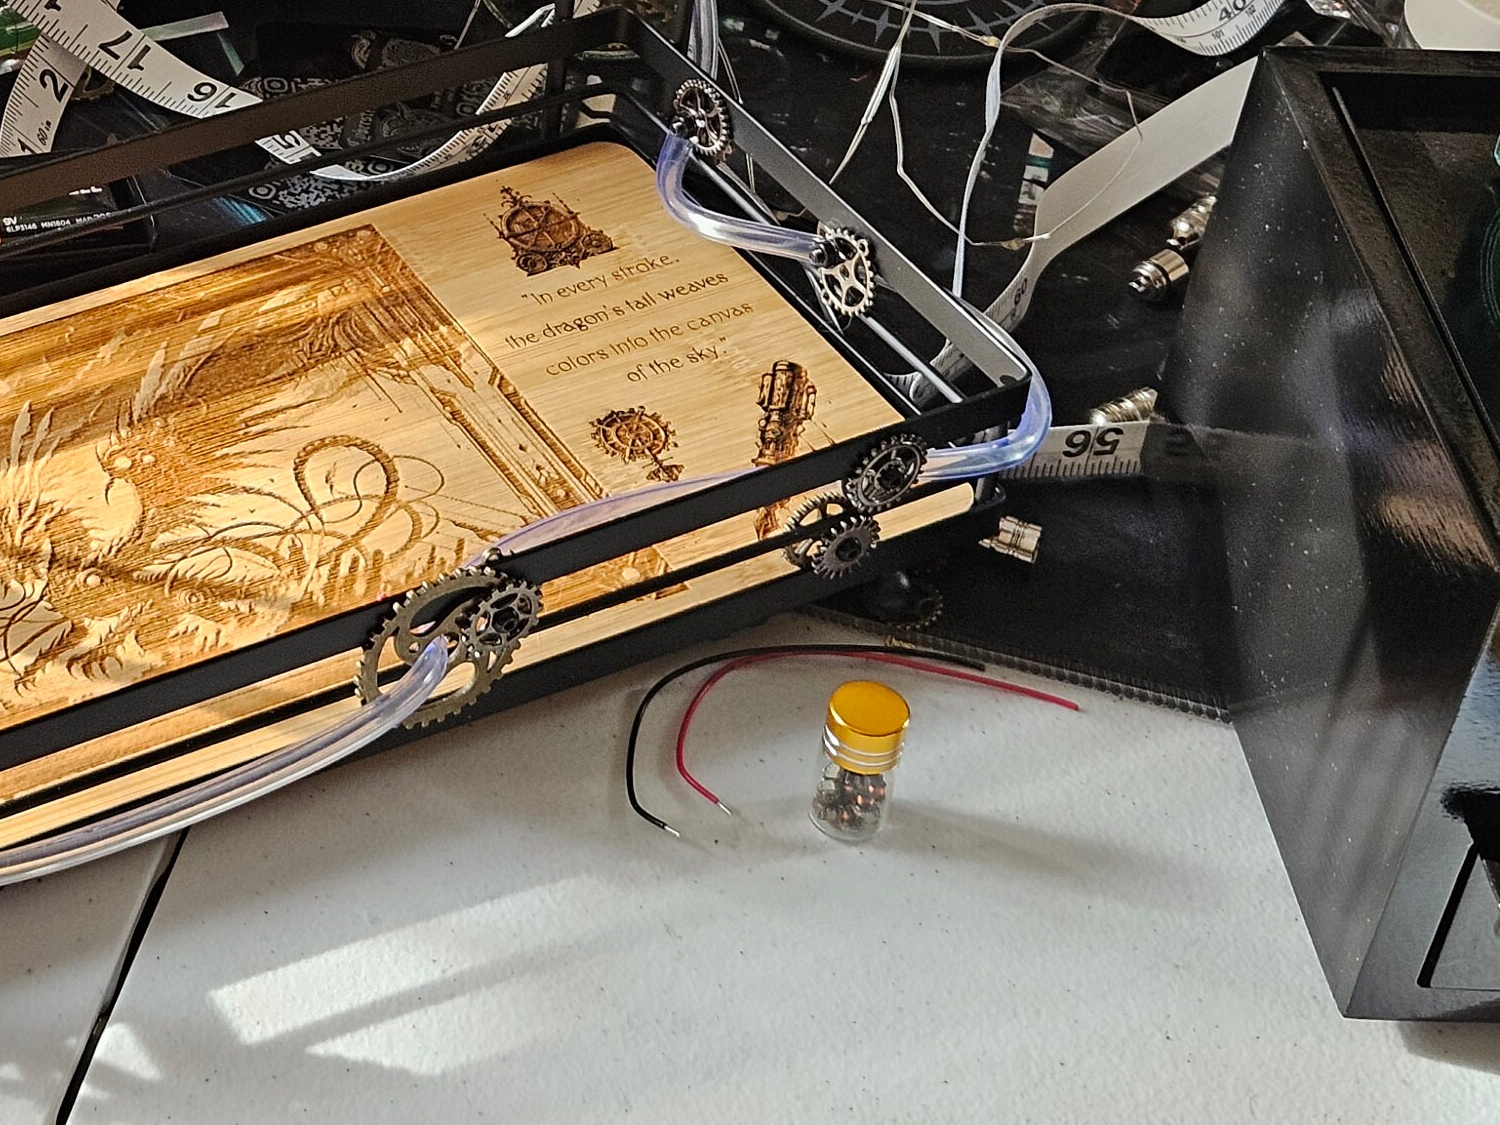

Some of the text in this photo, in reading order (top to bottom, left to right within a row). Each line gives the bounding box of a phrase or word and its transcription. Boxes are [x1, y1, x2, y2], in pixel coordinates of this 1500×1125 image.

[1212, 29, 1225, 40] 101
[98, 30, 151, 71] 17
[39, 68, 68, 103] 2
[187, 81, 237, 109] 16
[557, 273, 608, 299] every
[505, 331, 541, 350] the
[542, 305, 626, 339] dragon's
[658, 272, 729, 301] weaves
[546, 348, 610, 376] colors
[649, 323, 684, 343] the
[686, 301, 754, 331] canvas
[627, 364, 650, 383] of
[649, 355, 684, 374] the
[1062, 427, 1124, 458] 56
